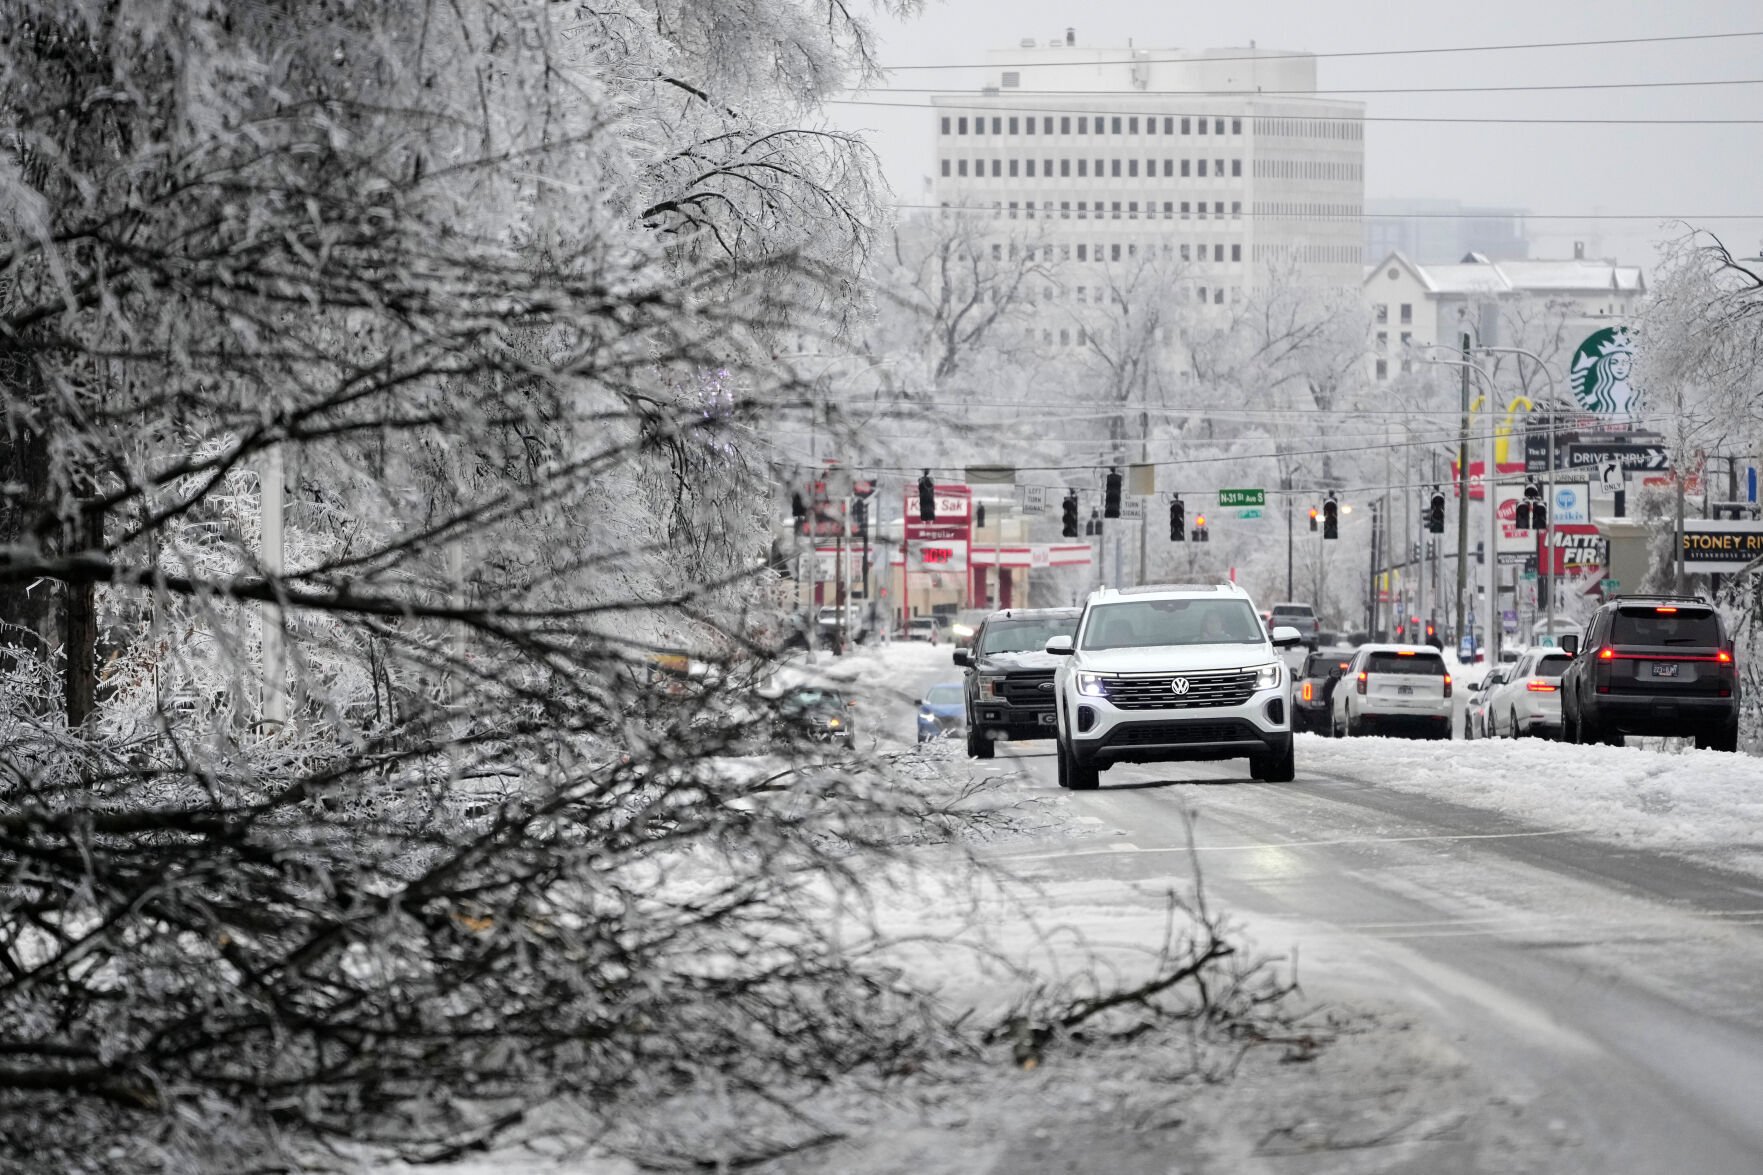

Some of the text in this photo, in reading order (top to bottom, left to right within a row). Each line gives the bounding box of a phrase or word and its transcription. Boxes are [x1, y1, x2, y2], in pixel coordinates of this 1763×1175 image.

[1573, 452, 1645, 464] DRIVE THRU
[1604, 483, 1622, 491] ONLY
[1257, 492, 1264, 502] S
[942, 500, 963, 511] Sak
[919, 530, 955, 539] Regular
[1683, 534, 1742, 549] STONEY
